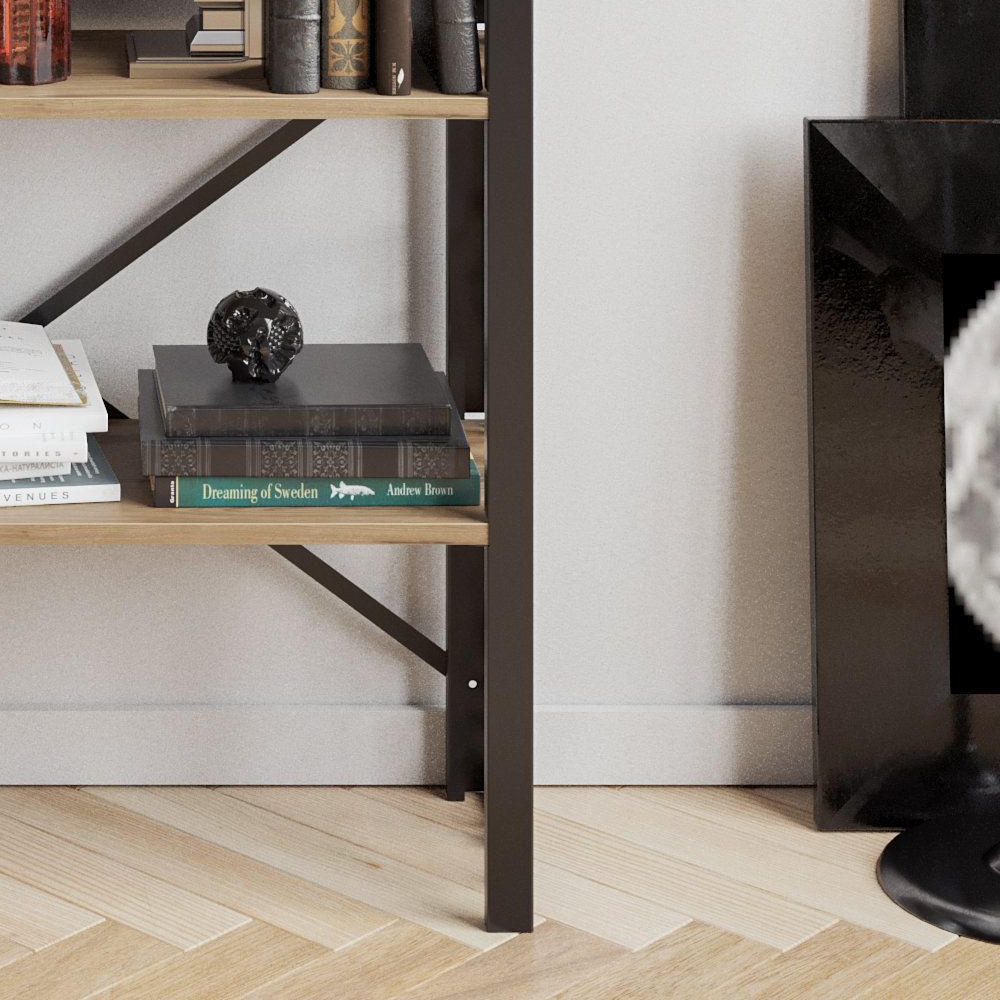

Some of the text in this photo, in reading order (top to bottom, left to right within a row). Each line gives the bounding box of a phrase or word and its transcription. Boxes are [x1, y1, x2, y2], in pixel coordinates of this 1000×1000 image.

[202, 482, 319, 503] Dreaming of Sweden
[386, 483, 454, 497] Andrew Brown
